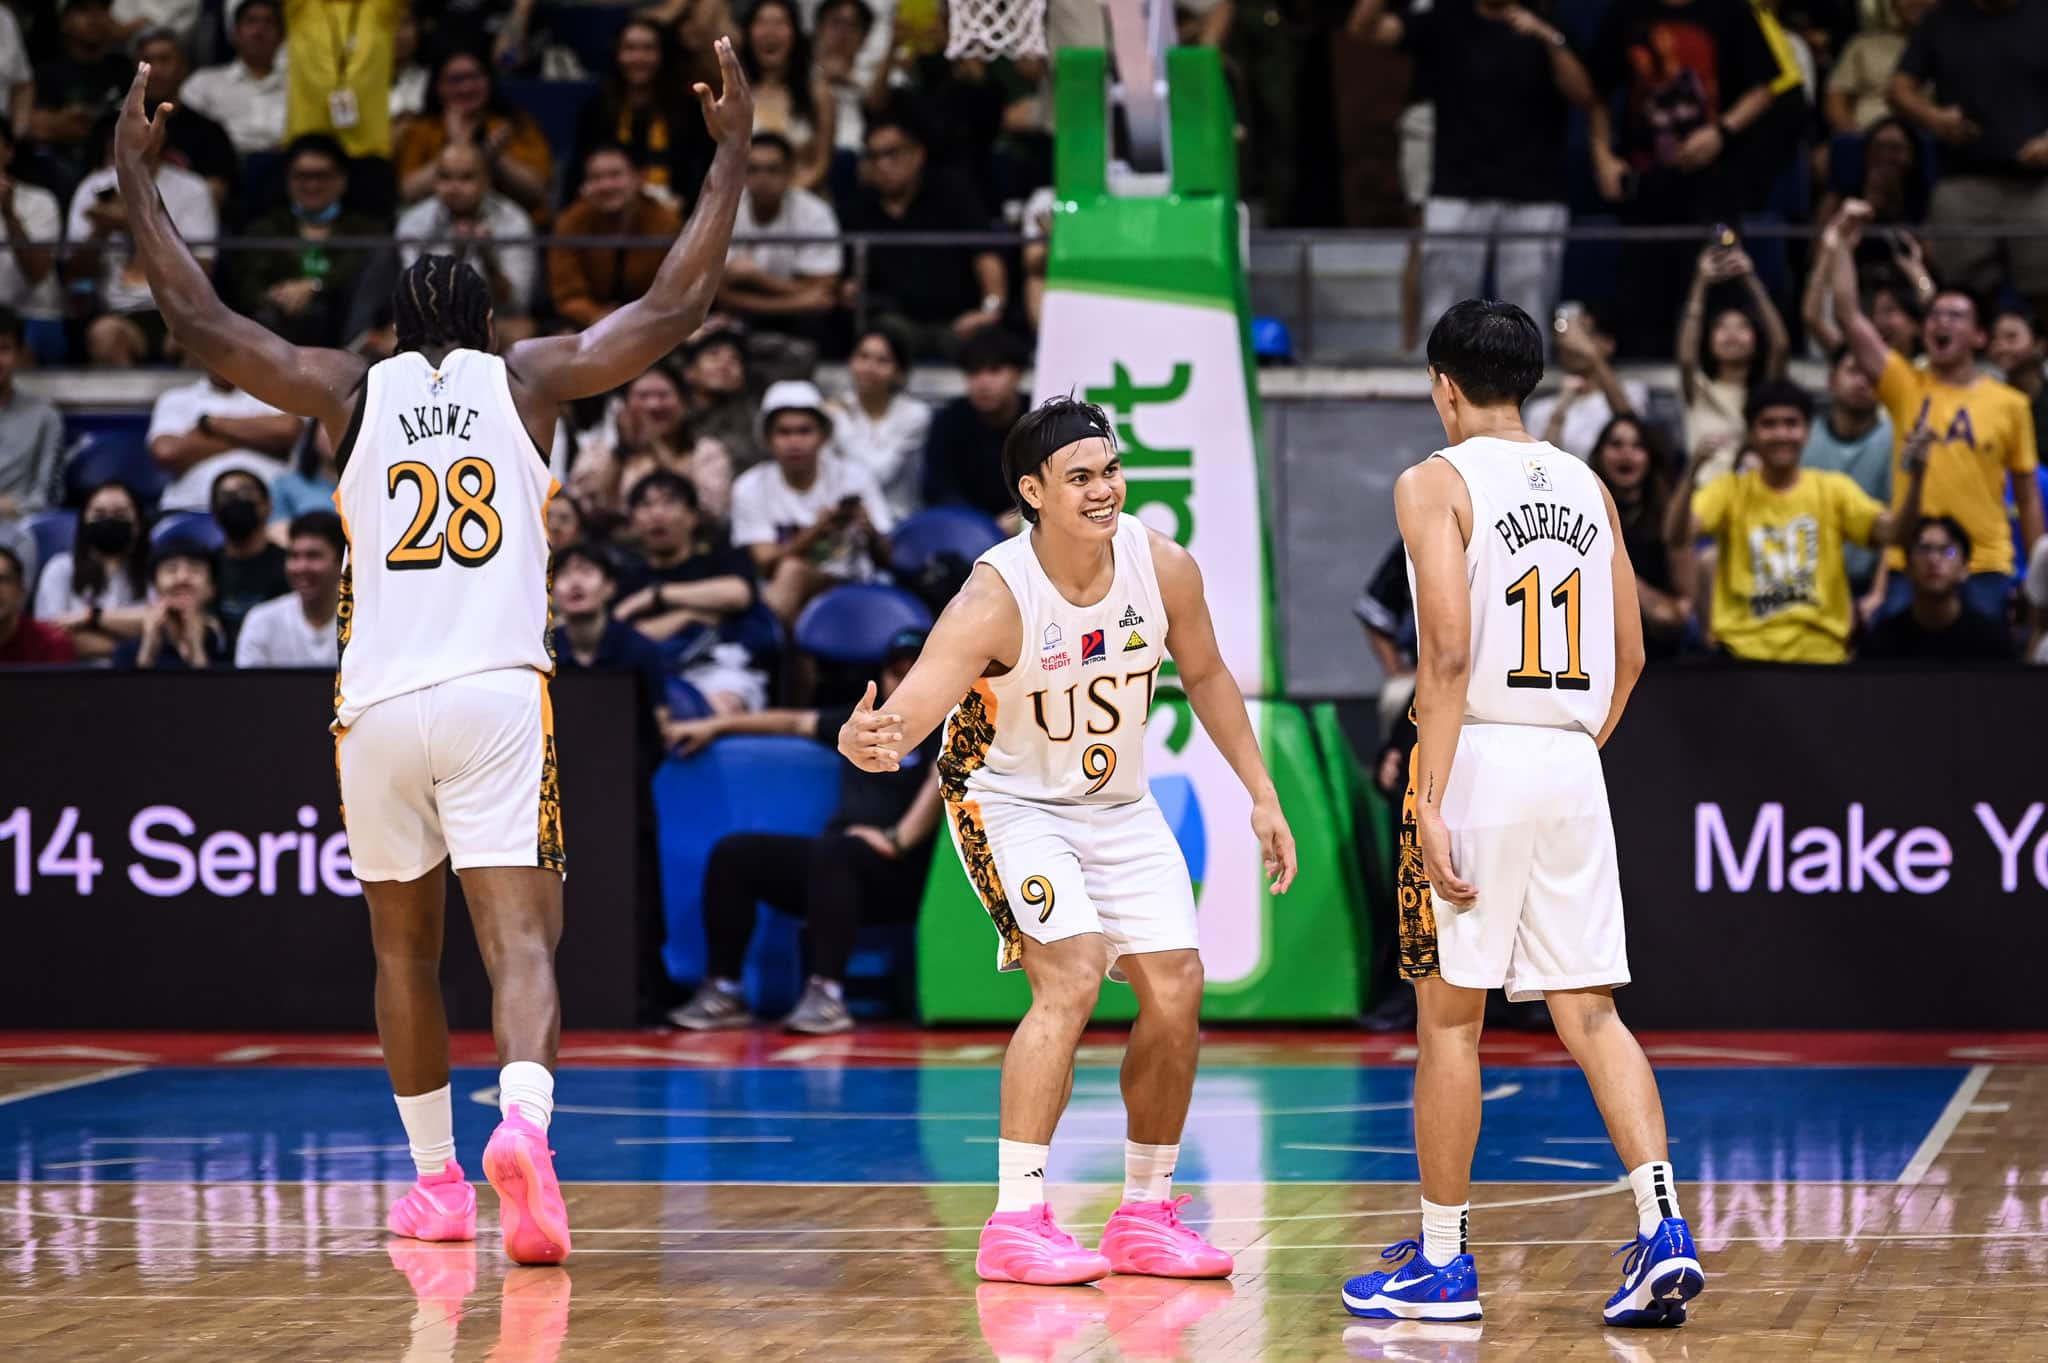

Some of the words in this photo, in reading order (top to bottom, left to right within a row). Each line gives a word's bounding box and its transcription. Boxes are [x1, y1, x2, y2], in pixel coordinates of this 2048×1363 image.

[398, 403, 479, 445] AKOWE
[386, 456, 503, 571] 28
[1494, 502, 1599, 557] PADRIGAO
[1118, 616, 1145, 628] DELTA
[1505, 564, 1590, 691] 11
[1041, 651, 1068, 664] HOME
[1042, 658, 1071, 672] CREDIT
[1025, 655, 1162, 742] UST
[1082, 743, 1117, 796] 9
[0, 805, 104, 897] 14
[1694, 801, 1954, 895] Make
[1973, 801, 2048, 895] Y
[1021, 874, 1056, 924] 9
